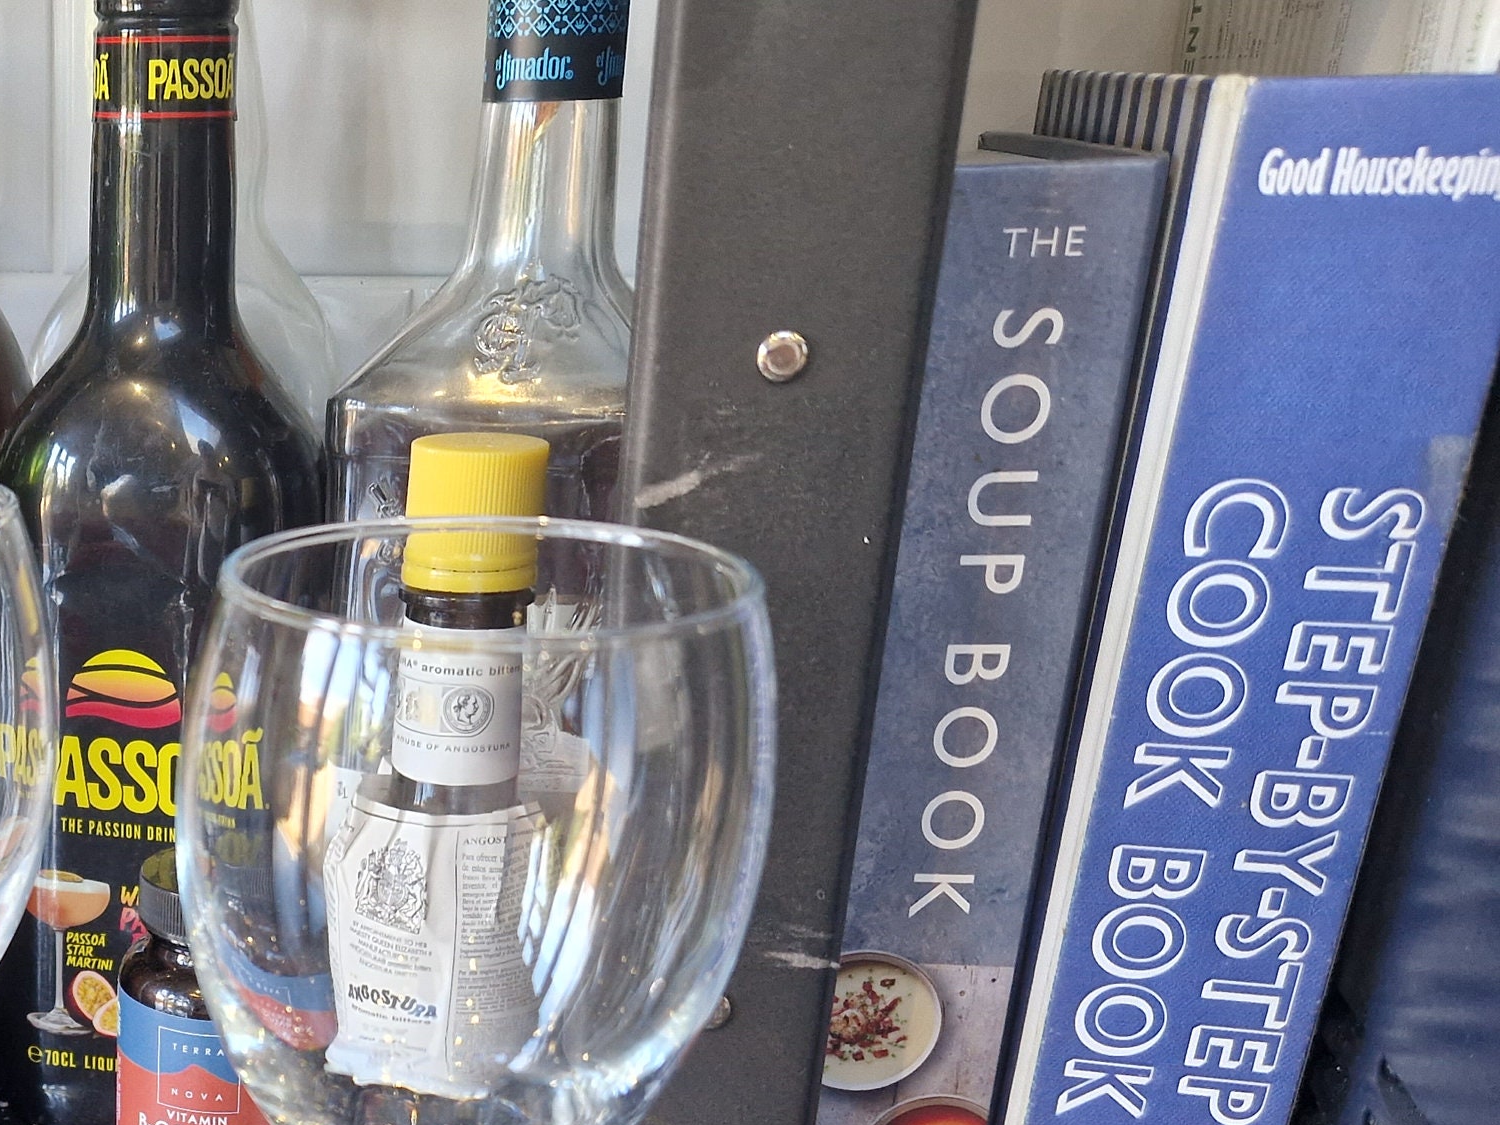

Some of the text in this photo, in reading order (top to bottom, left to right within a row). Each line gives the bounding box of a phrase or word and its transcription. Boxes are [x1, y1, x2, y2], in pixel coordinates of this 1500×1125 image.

[148, 52, 235, 100] PASSOÃ
[496, 46, 572, 90] Jimador
[1258, 146, 1500, 202] Good Housekeepin
[908, 226, 1087, 919] THE SOUP BOOK
[421, 663, 483, 677] aromatic
[426, 742, 441, 751] OF
[444, 741, 512, 753] ANGOSTURA
[1055, 477, 1290, 1120] COOK BOOK
[60, 817, 176, 843] THE PASSION DRIN
[66, 931, 107, 947] PASSOÃ
[66, 944, 94, 957] STAR
[66, 955, 114, 971] MARTINI
[348, 983, 439, 1019] ANGOSTURA
[45, 1049, 119, 1072] 70CL LIQU
[172, 1043, 225, 1057] TERRA
[170, 1087, 223, 1102] NOVA
